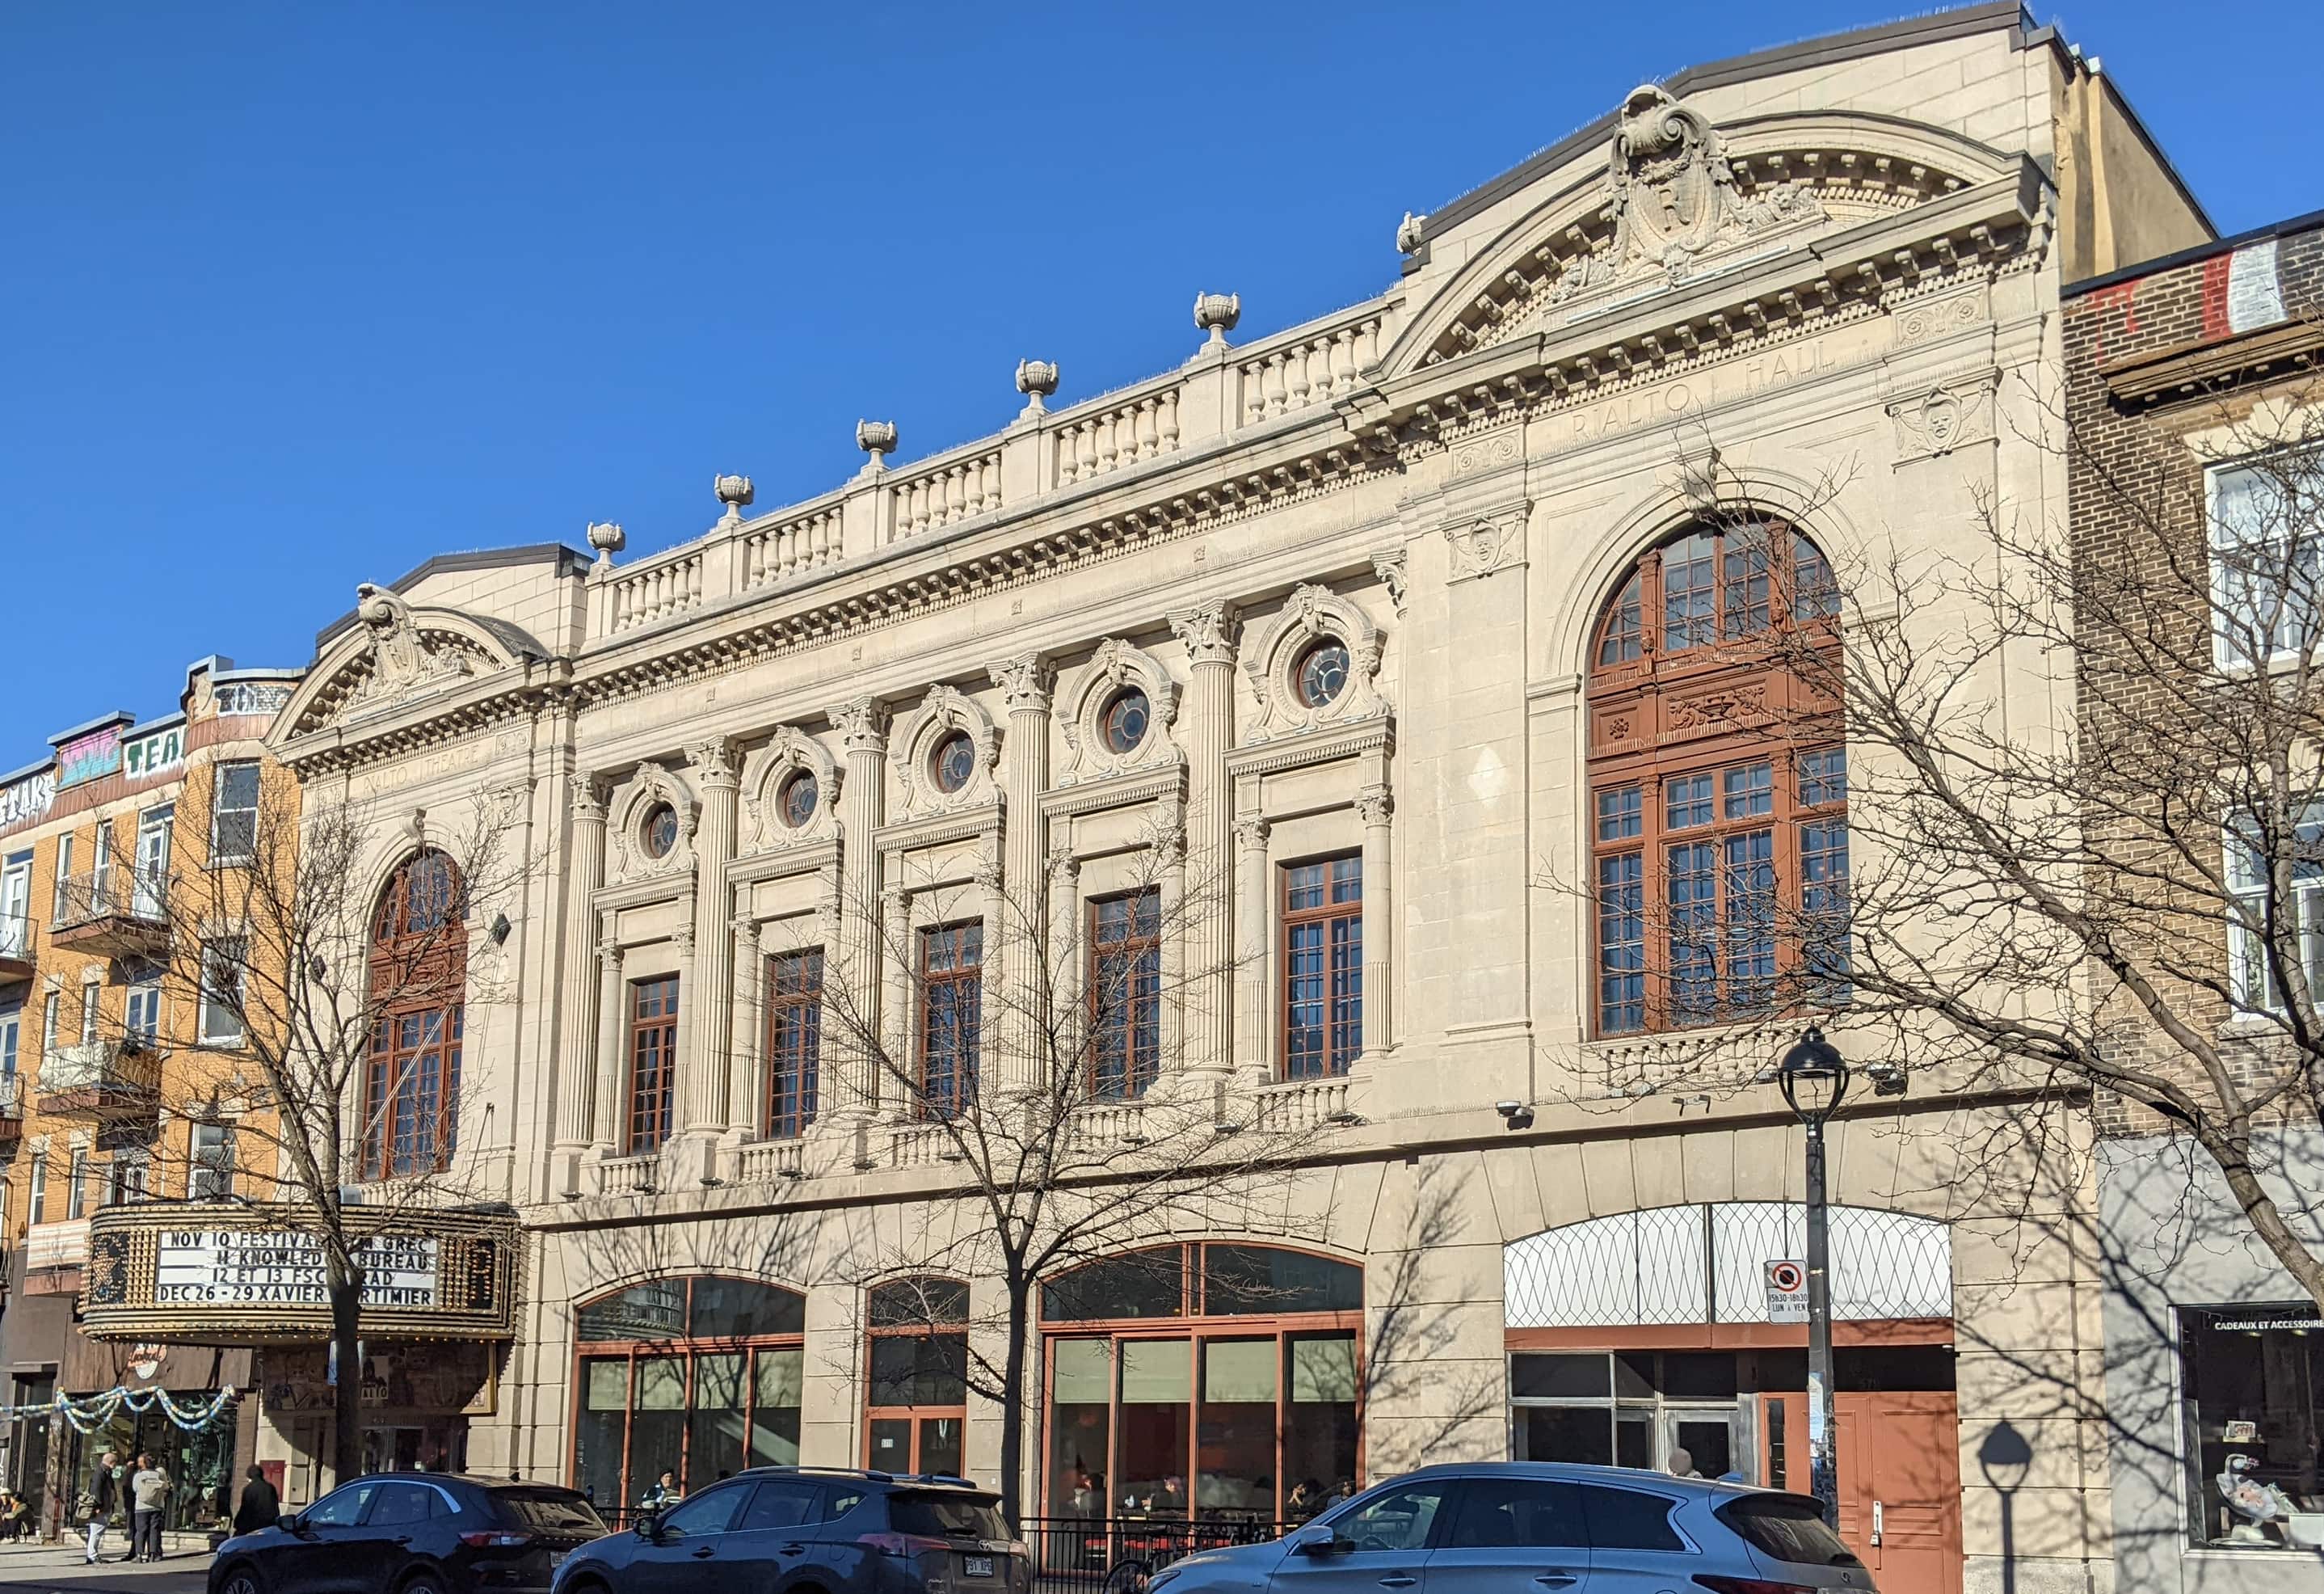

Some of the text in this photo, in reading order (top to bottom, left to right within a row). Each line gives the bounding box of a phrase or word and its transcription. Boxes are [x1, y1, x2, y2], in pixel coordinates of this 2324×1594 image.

[1572, 340, 1836, 441] RIALTO HALL
[425, 744, 479, 778] THEATRE
[171, 1232, 202, 1246] NOV
[213, 1233, 229, 1246] 10
[383, 1236, 427, 1252] GREC
[239, 1250, 324, 1266] KNOWLED
[358, 1254, 427, 1270] BUREAU
[213, 1269, 228, 1283] 12
[237, 1269, 256, 1284] ET
[267, 1269, 283, 1283] 13
[160, 1287, 190, 1301] DEC
[196, 1287, 215, 1301] 26
[233, 1287, 254, 1301] 29
[259, 1286, 324, 1301] XAVIER
[359, 1288, 431, 1305] RTIMIER
[1772, 1304, 1784, 1312] LUN
[2215, 1321, 2256, 1330] CADEAUX
[2259, 1321, 2269, 1330] ET
